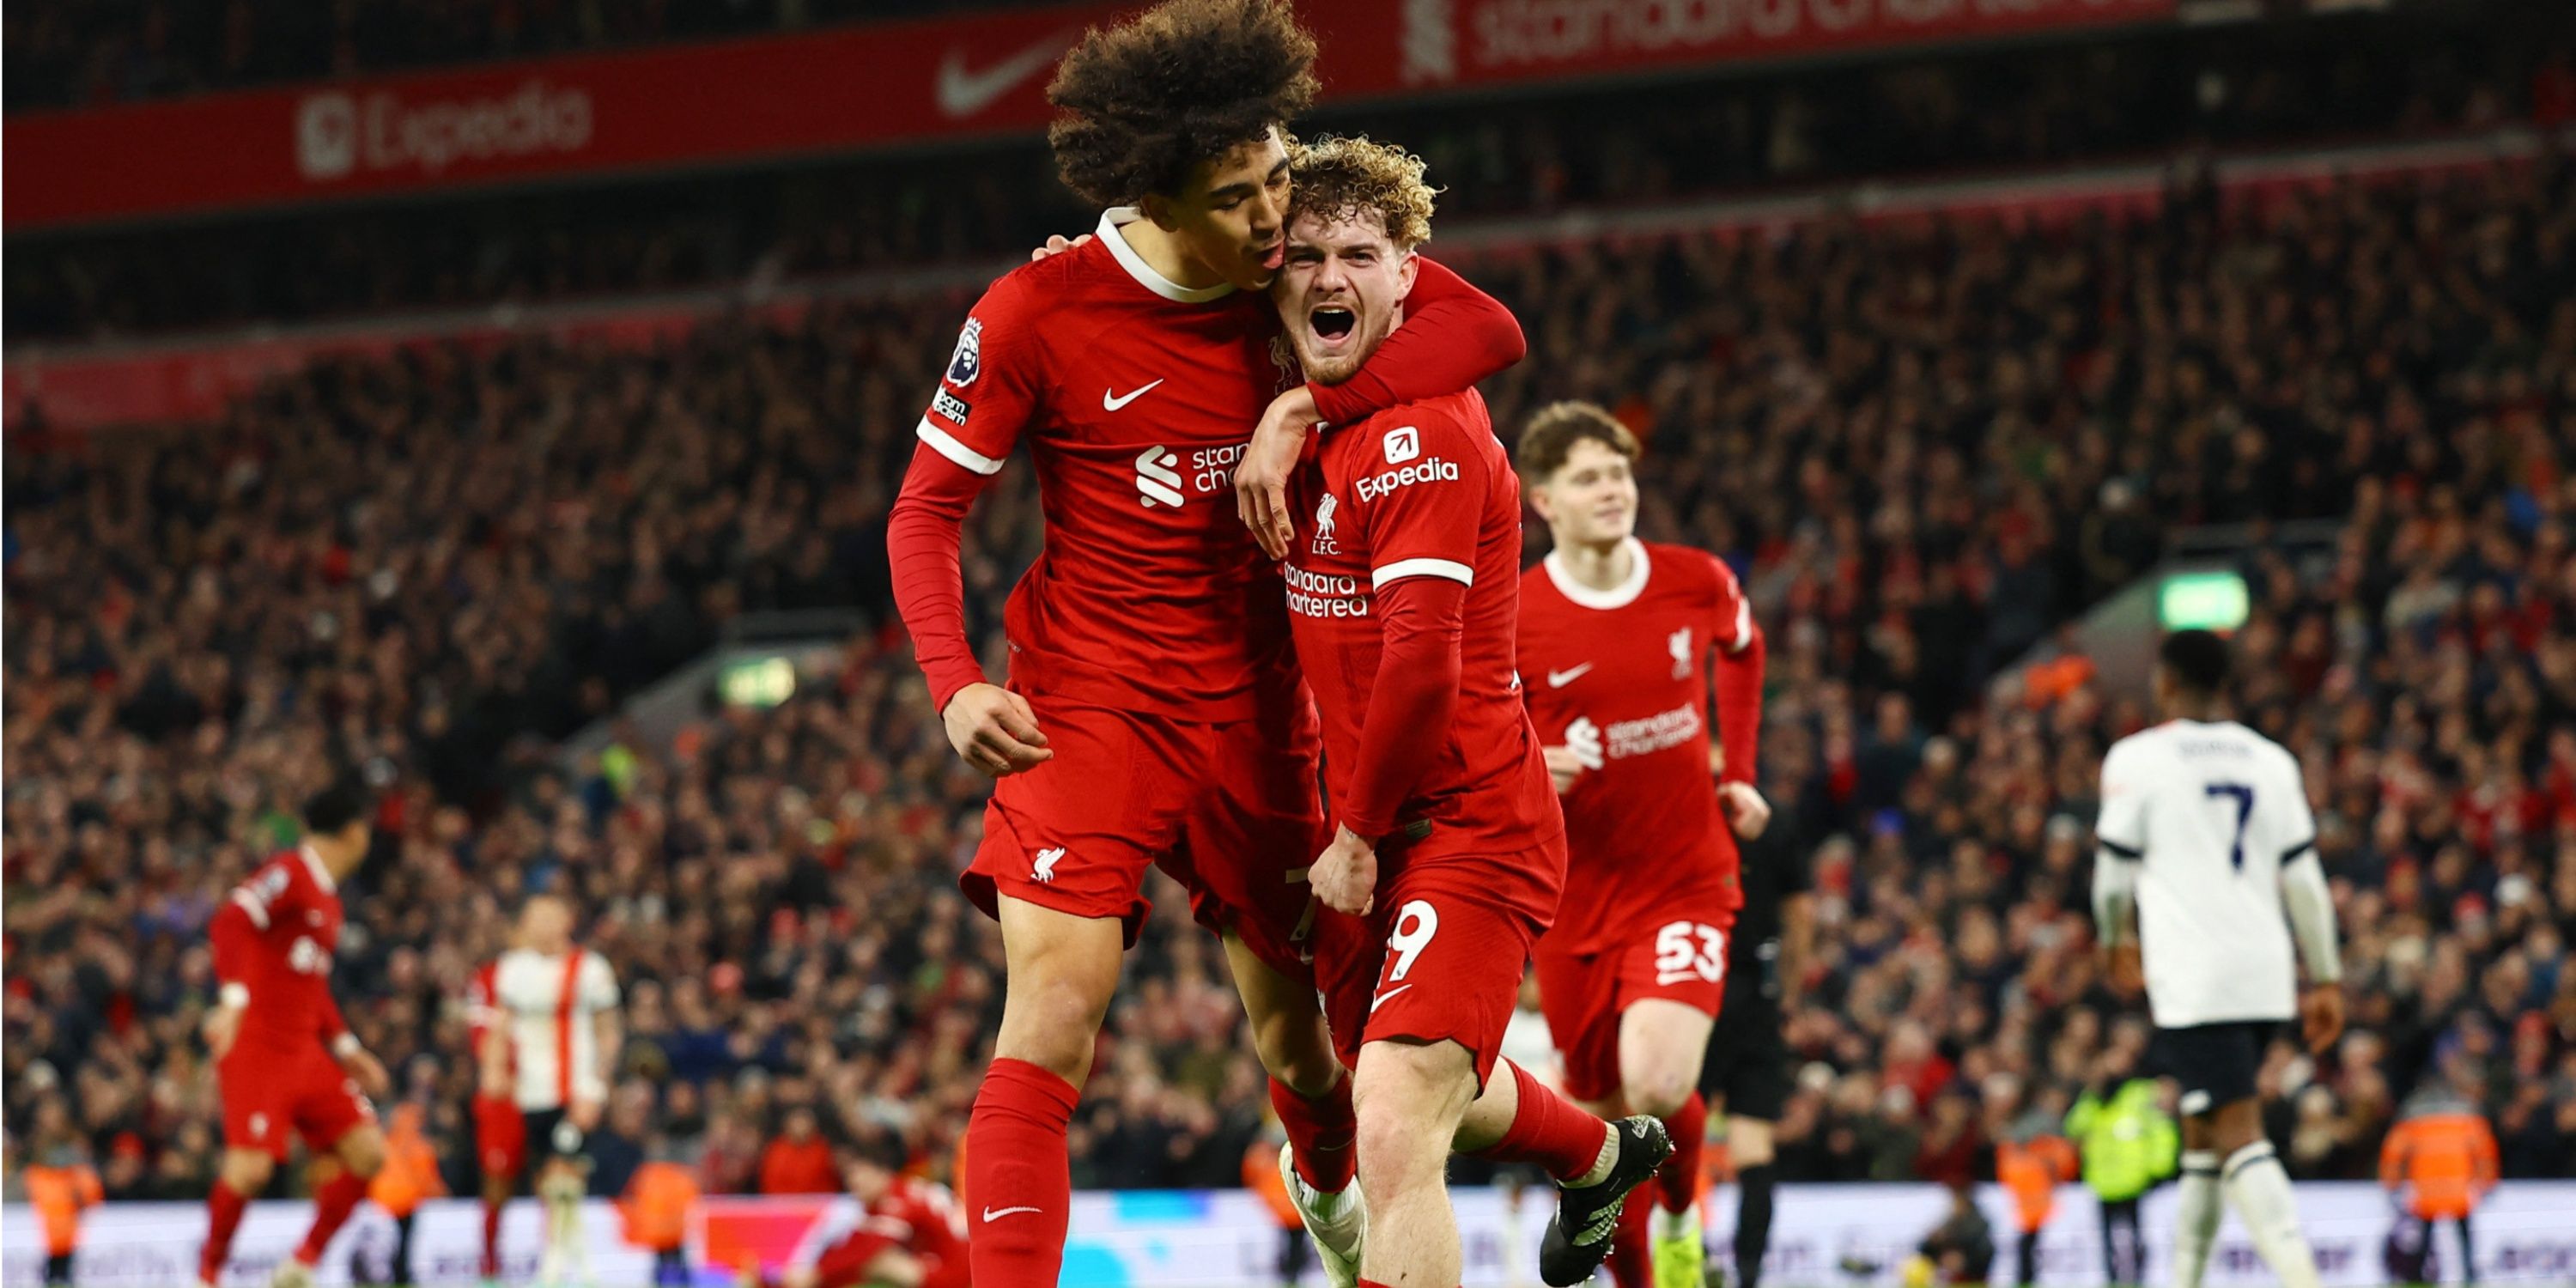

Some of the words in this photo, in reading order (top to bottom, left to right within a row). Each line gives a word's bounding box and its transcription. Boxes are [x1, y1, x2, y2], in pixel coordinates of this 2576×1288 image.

[1356, 457, 1458, 502] Expedia
[2204, 781, 2254, 872] 7
[1376, 899, 1438, 989] 9
[1654, 920, 1725, 984] 53
